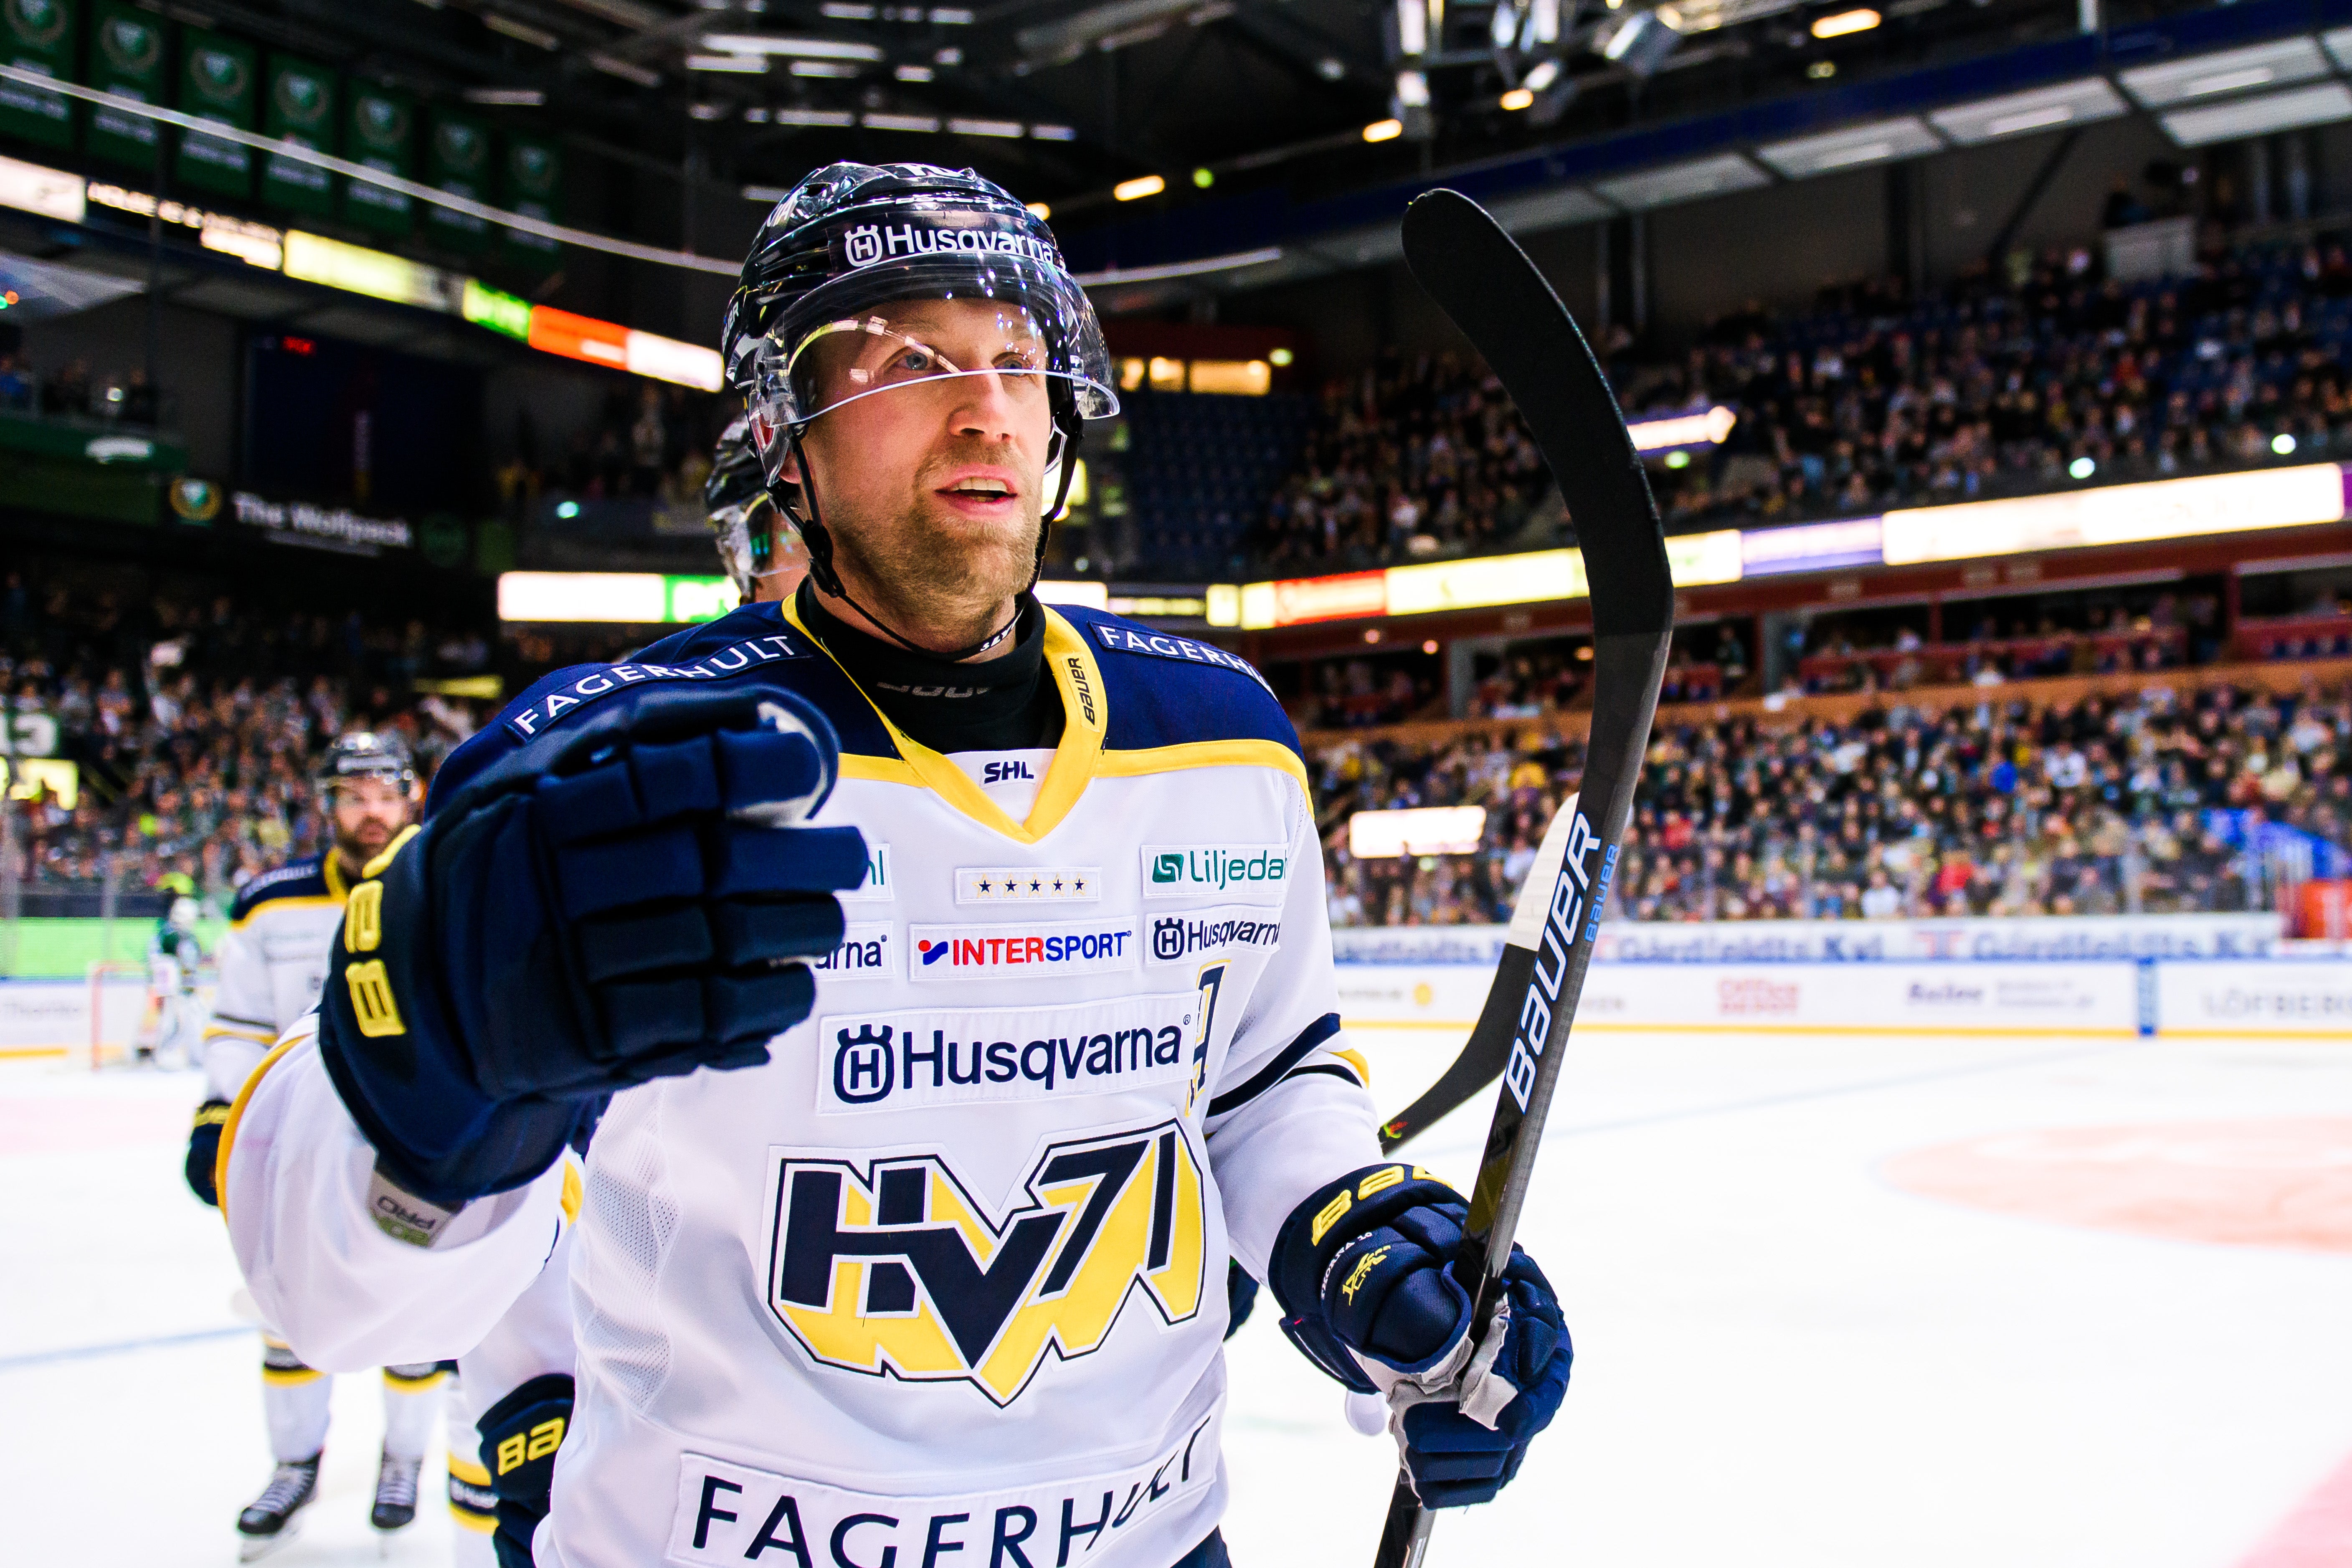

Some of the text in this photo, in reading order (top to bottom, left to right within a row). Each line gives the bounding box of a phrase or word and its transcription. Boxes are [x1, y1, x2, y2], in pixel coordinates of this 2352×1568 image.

[885, 224, 1054, 265] Husqvarna
[514, 636, 795, 735] FAGERHULT
[1067, 658, 1095, 726] BAUER
[984, 761, 1034, 784] SHL
[1584, 843, 1620, 942] BAUER
[953, 932, 1126, 966] INTERSPORT
[1505, 811, 1601, 1115] BAUER
[903, 1025, 1183, 1090] Husqvarna
[692, 1416, 1212, 1568] FAGERHULT
